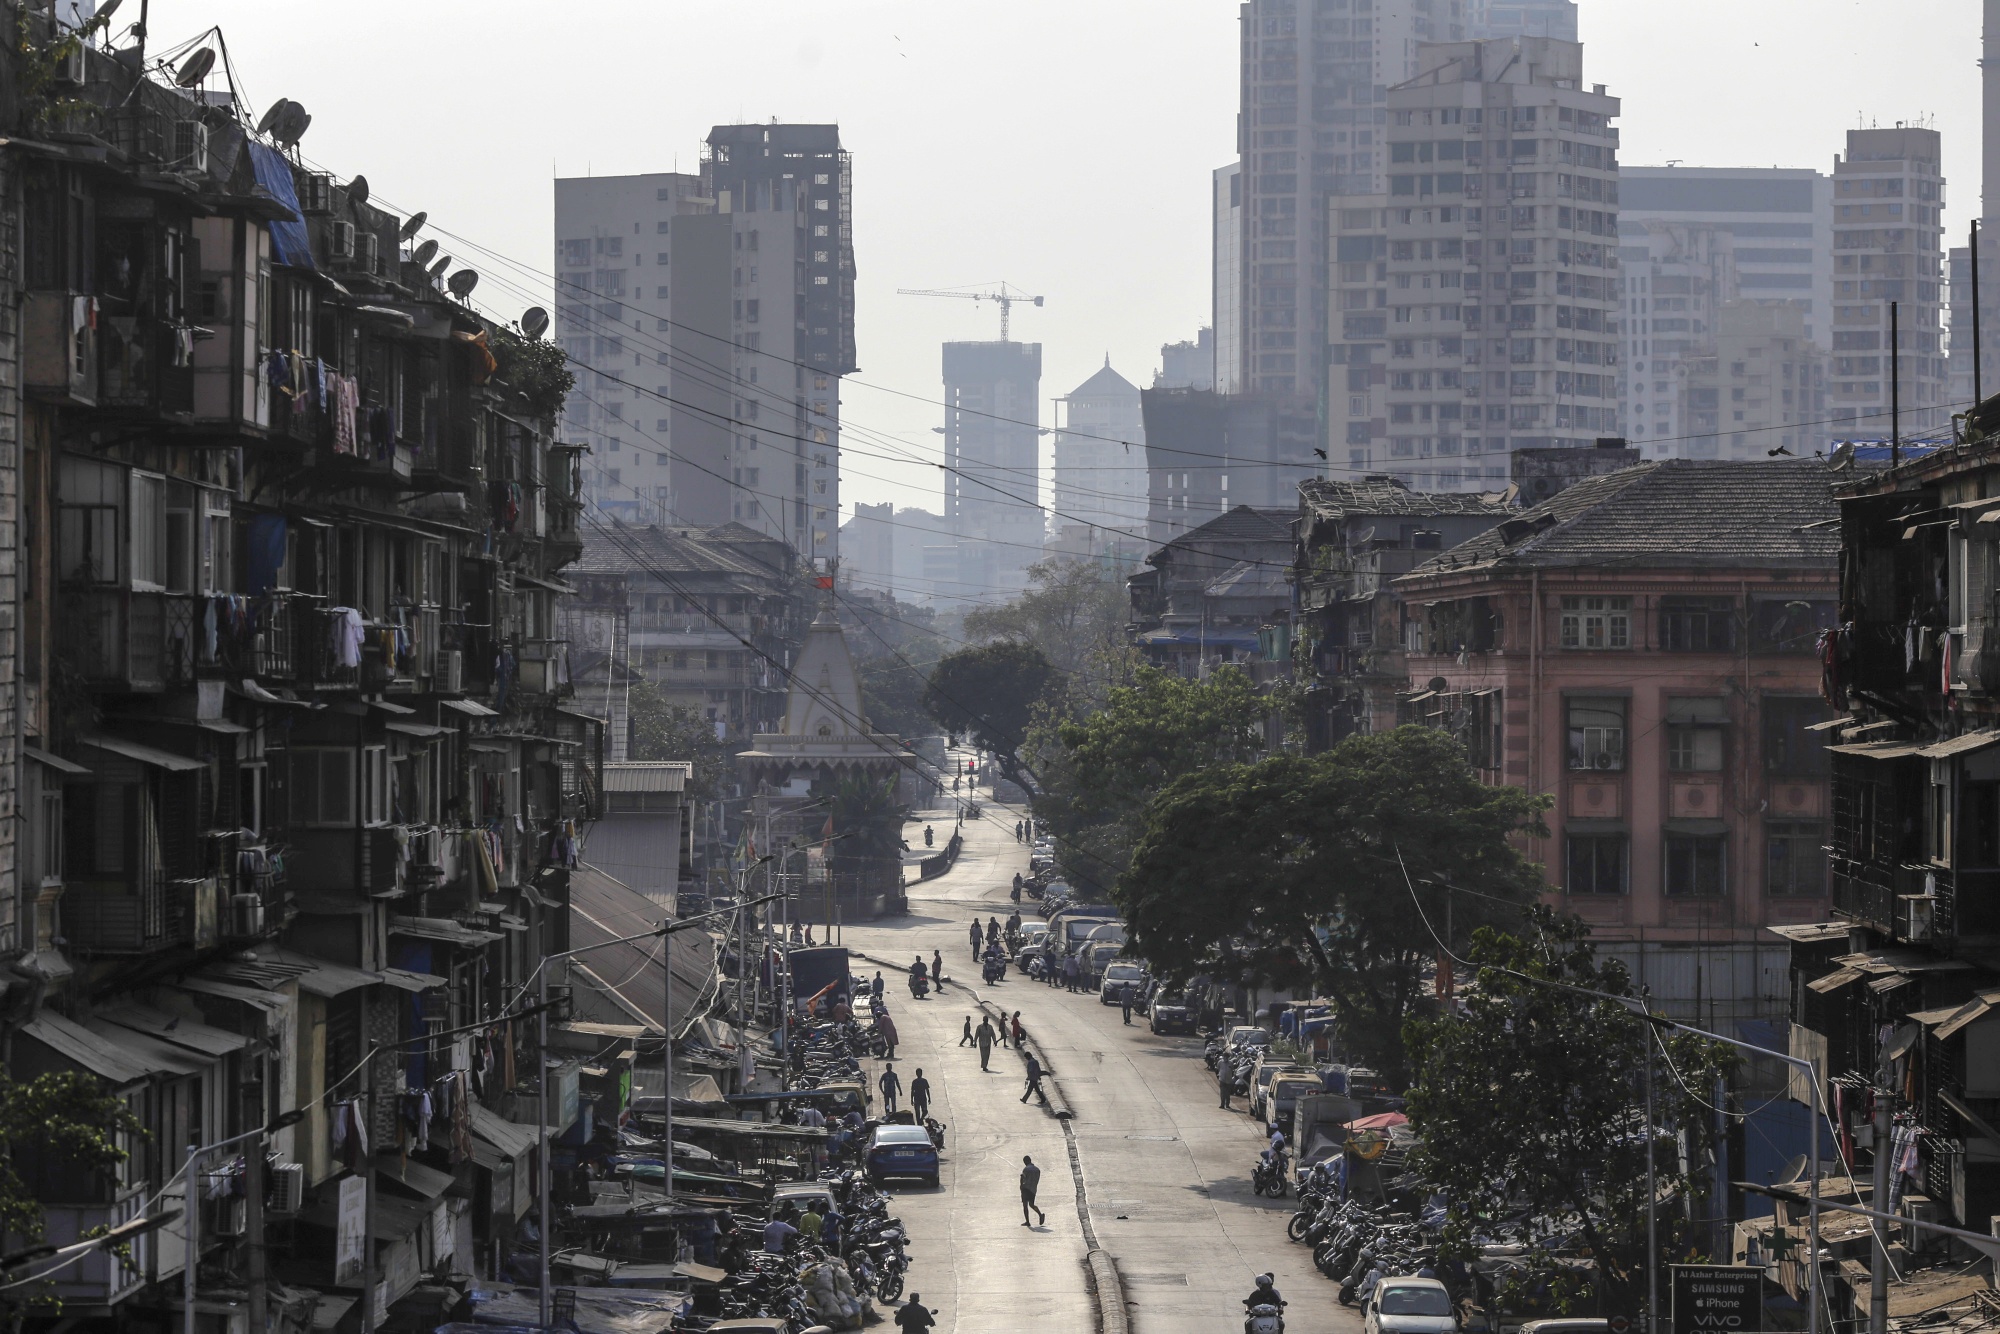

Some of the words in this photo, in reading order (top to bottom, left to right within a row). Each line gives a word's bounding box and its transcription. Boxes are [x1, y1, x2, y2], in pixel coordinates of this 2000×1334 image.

[1679, 1270, 1688, 1279] Al
[1690, 1270, 1712, 1279] Azhar
[1714, 1271, 1758, 1281] Enterprises
[1691, 1283, 1745, 1294] SAMSUNG
[1706, 1298, 1740, 1308] iPhone
